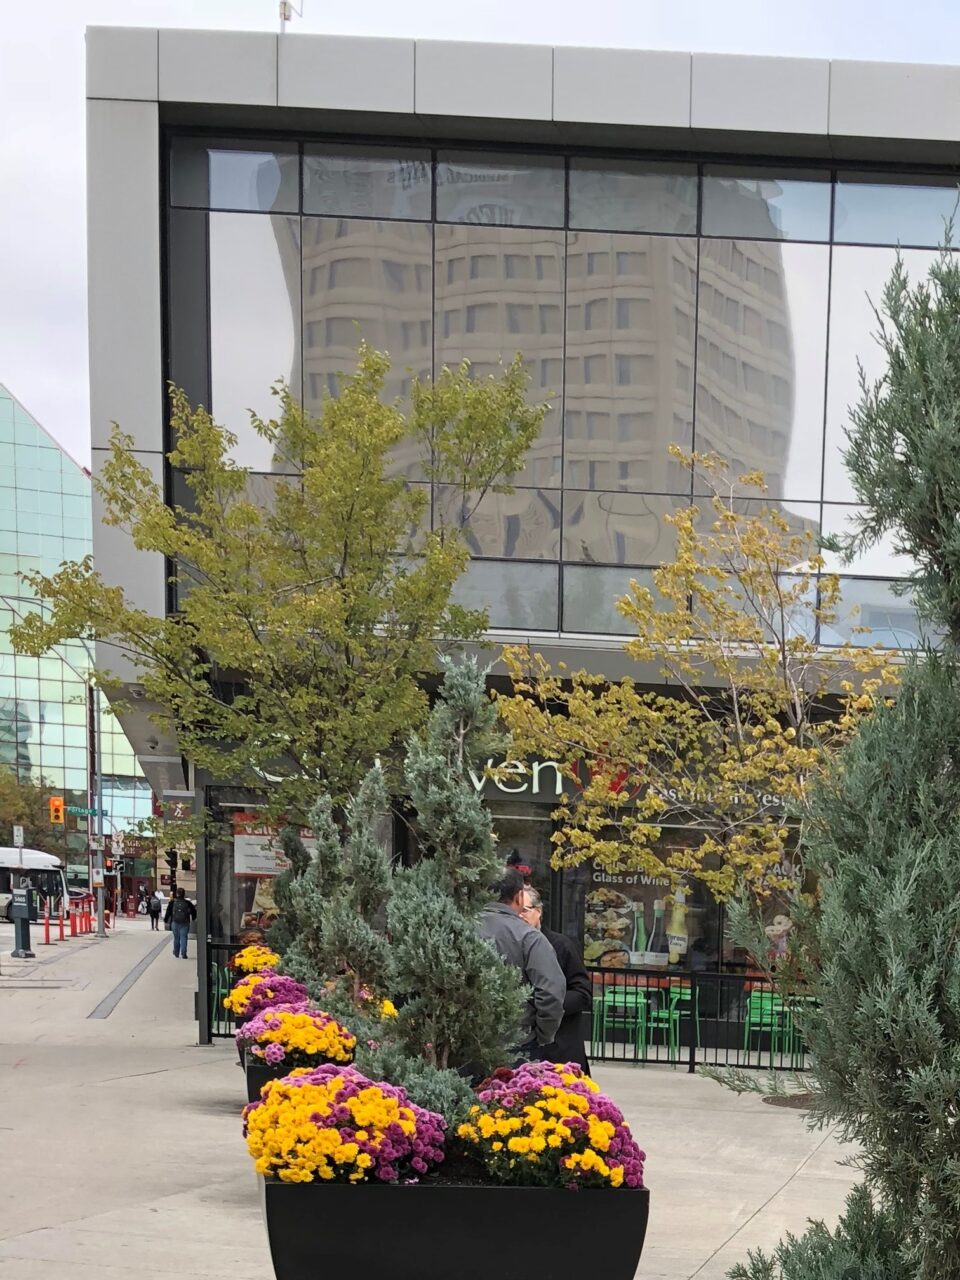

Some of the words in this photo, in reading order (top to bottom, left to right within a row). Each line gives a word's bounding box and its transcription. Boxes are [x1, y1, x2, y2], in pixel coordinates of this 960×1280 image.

[467, 757, 563, 795] ven
[593, 872, 623, 883] Glass
[625, 875, 639, 885] of
[640, 876, 670, 887] Wine
